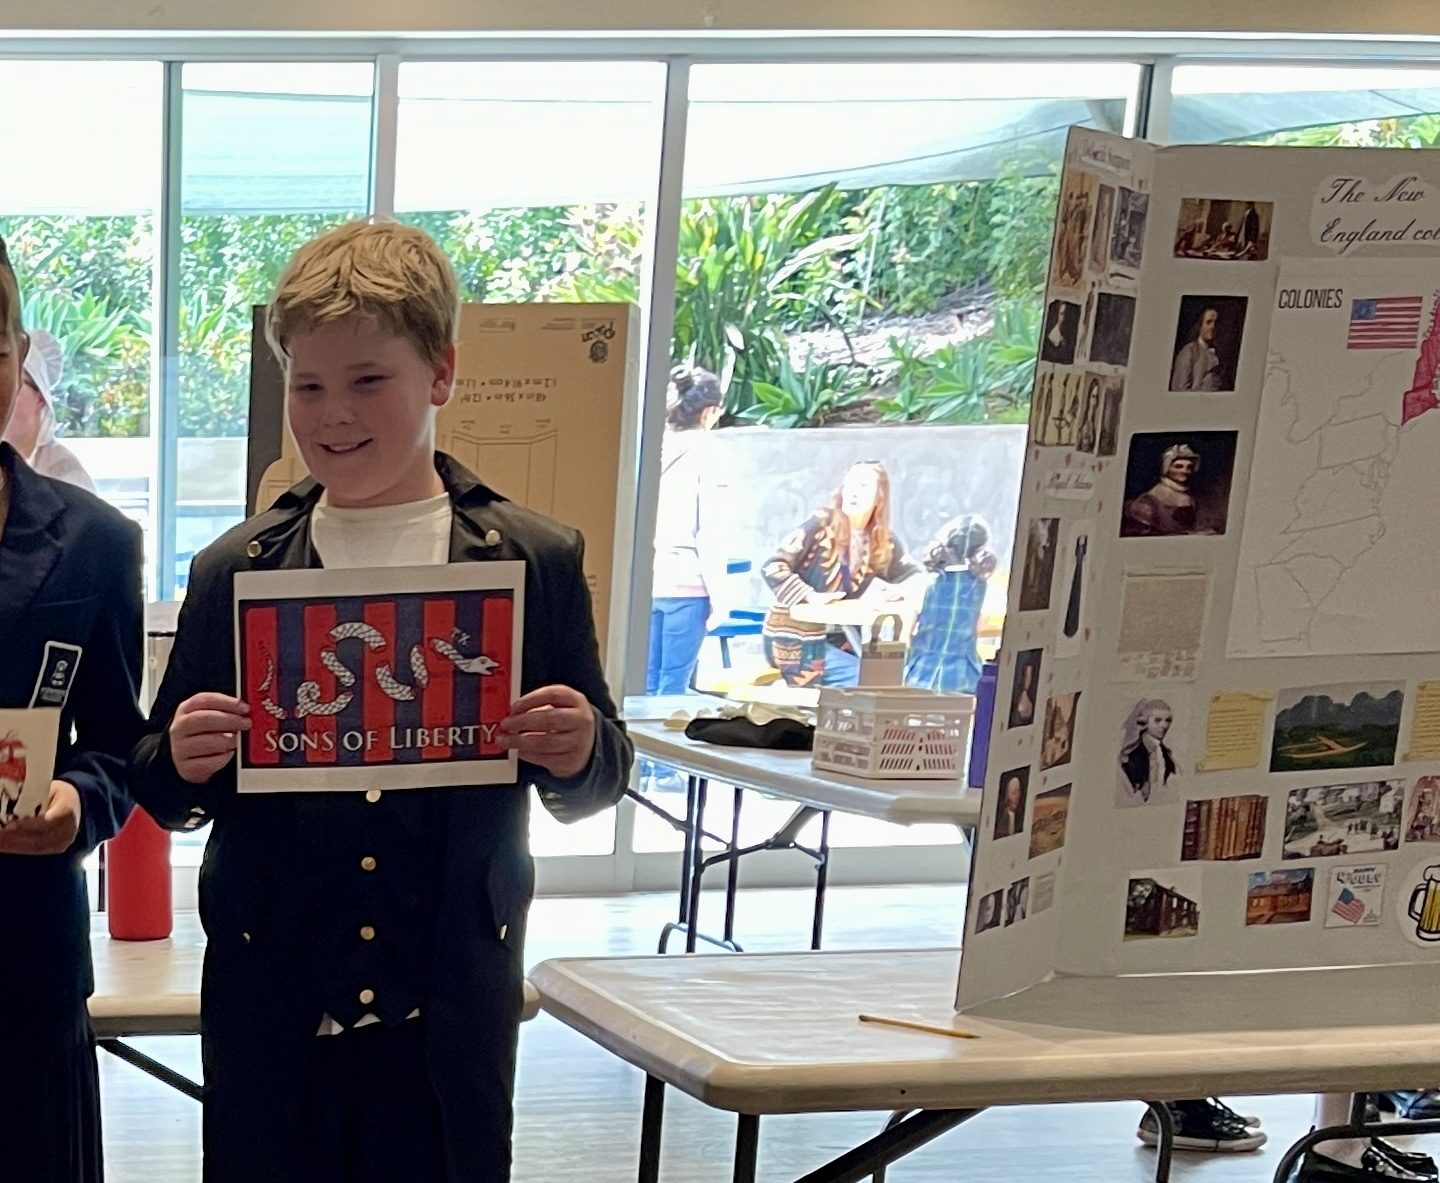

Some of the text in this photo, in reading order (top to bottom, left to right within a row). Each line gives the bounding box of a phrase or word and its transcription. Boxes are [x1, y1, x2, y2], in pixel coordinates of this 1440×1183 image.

[1321, 176, 1426, 204] The New
[1320, 217, 1417, 255] England
[1278, 288, 1344, 309] COLONIES
[264, 722, 499, 753] SONS OF LIBERTY
